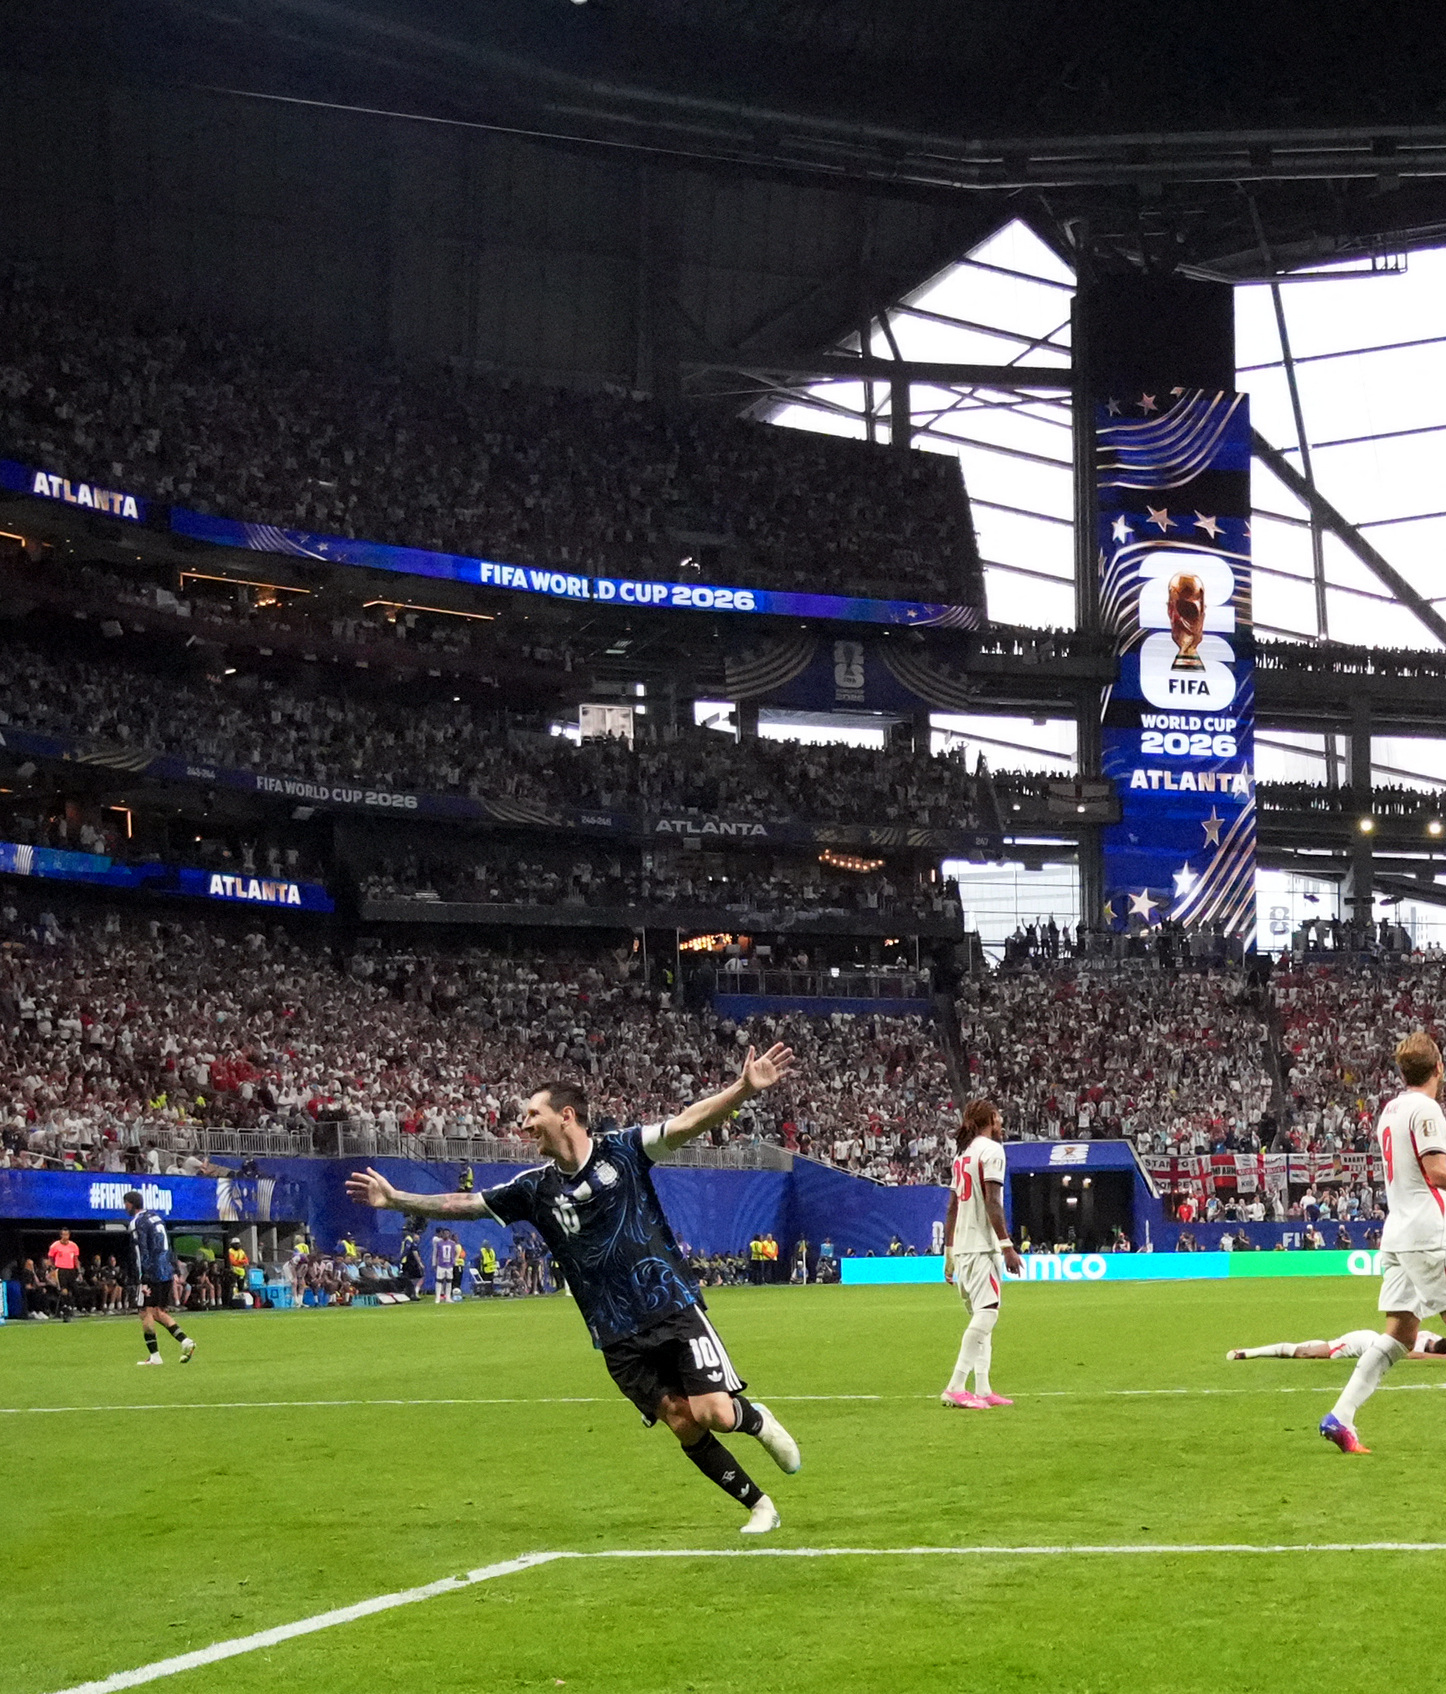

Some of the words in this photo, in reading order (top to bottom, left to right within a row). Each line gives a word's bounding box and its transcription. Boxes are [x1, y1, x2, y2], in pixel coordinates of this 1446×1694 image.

[33, 471, 139, 520] ATLANTA
[480, 562, 528, 589] FIFA
[530, 570, 616, 600] WORLD
[620, 581, 668, 604] CUP
[671, 586, 756, 611] 2026
[1168, 678, 1211, 696] FIFA
[1140, 713, 1202, 731] WORLD
[1203, 716, 1237, 733] CUP
[1140, 731, 1238, 758] 2026
[256, 775, 284, 793] FIFA
[285, 780, 330, 801] WORLD
[332, 788, 363, 803] CUP
[365, 791, 418, 809] 2026
[1130, 769, 1249, 794] ATLANTA
[655, 819, 769, 837] ATLANTA
[209, 873, 302, 905] ATLANTA
[1382, 1126, 1394, 1187] 9
[154, 1223, 169, 1251] 7
[551, 1207, 581, 1238] 10
[1282, 1232, 1326, 1248] FIA
[688, 1336, 721, 1370] 10
